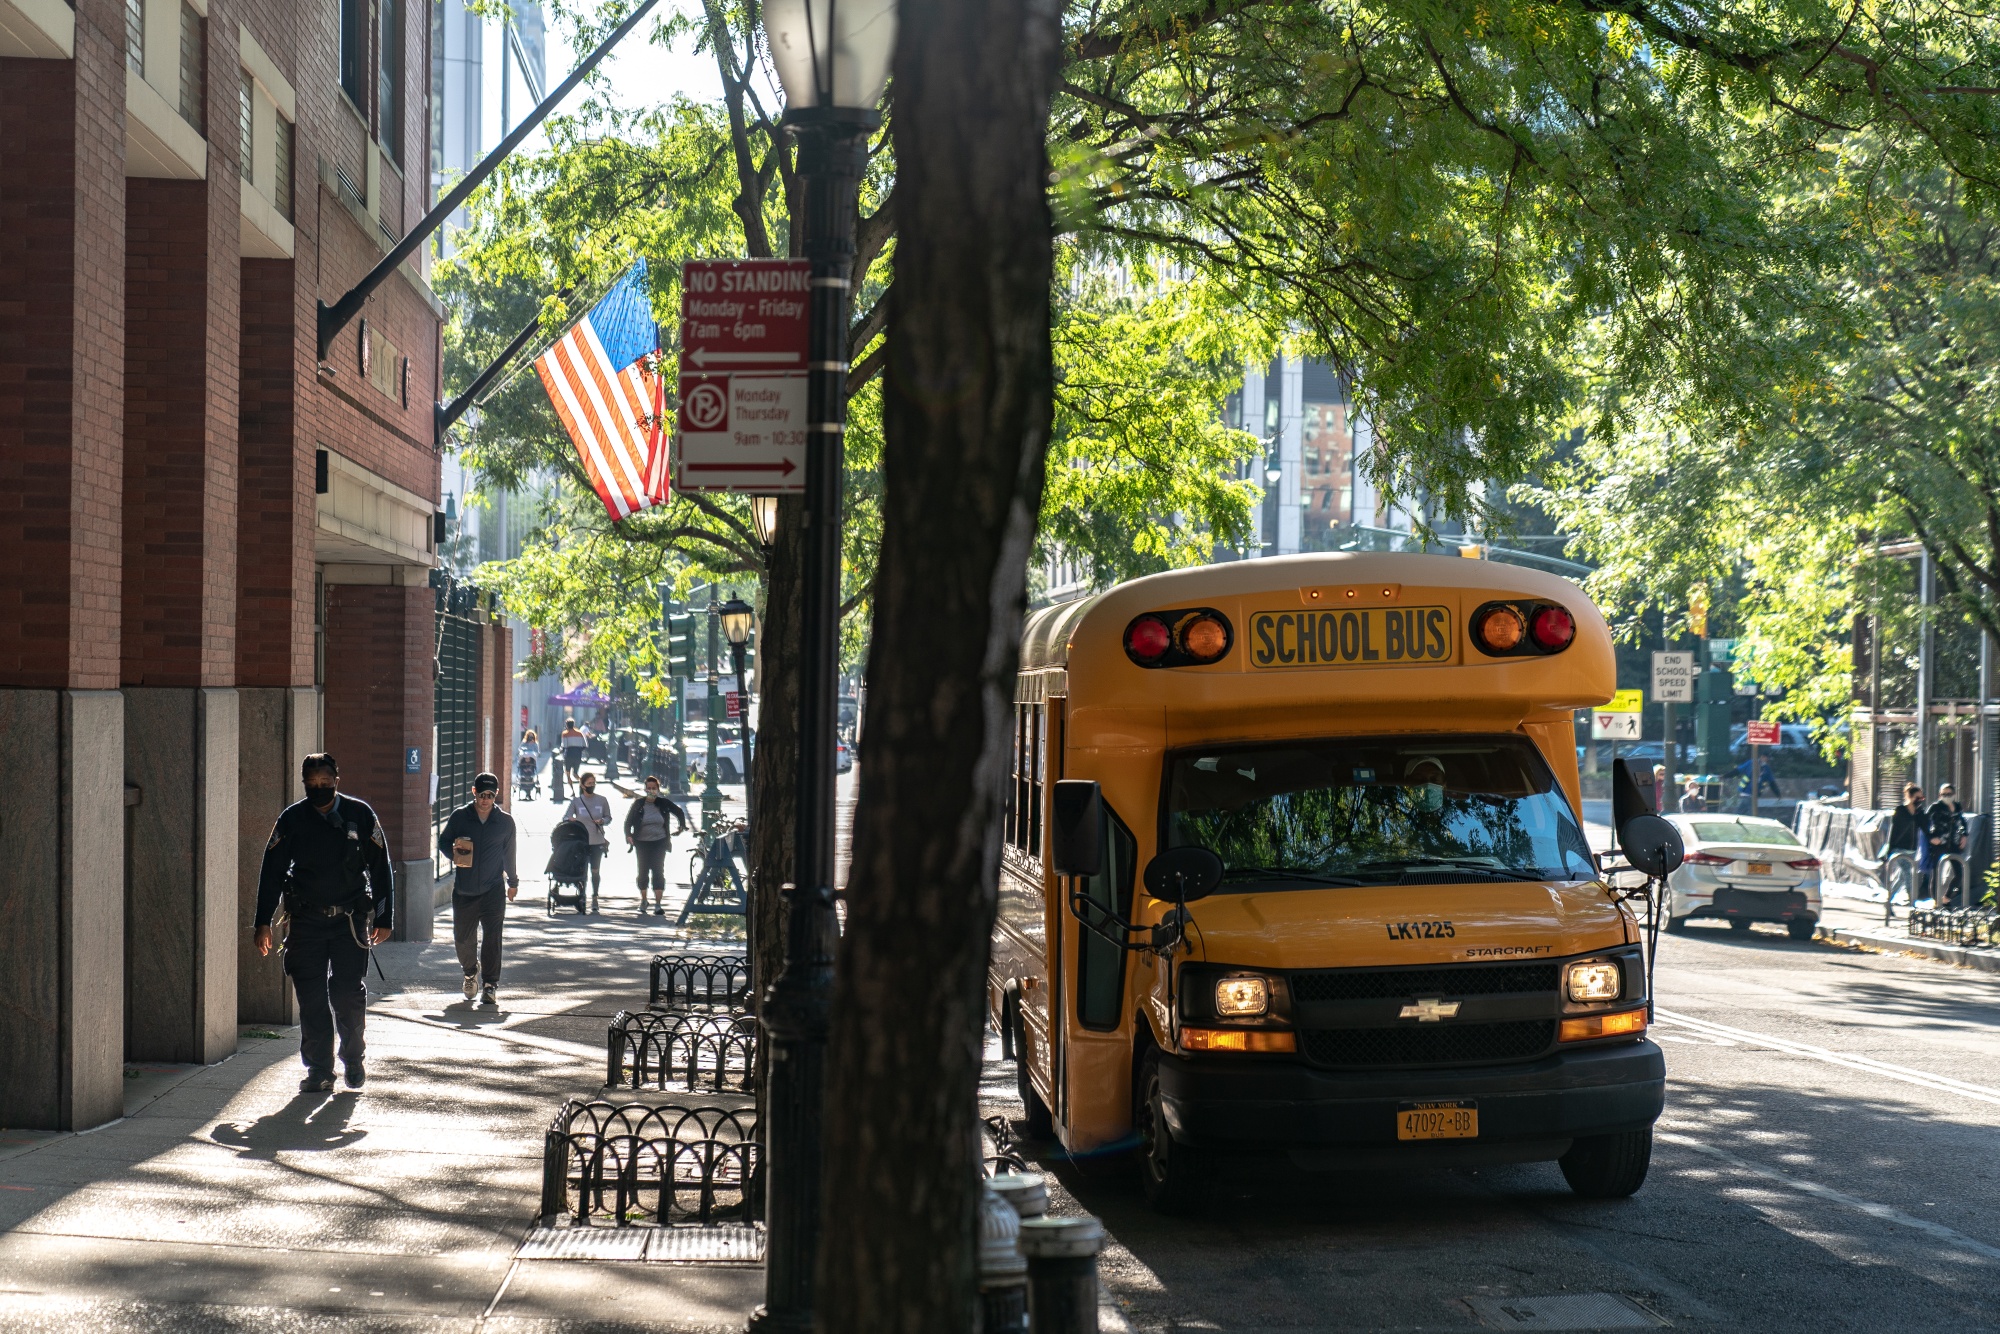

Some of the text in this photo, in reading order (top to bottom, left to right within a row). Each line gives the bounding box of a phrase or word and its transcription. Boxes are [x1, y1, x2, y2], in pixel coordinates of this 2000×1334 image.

[688, 270, 812, 293] NO STANDING
[688, 299, 746, 319] Monday
[758, 299, 804, 319] Friday
[688, 321, 720, 338] 7am
[733, 321, 766, 341] 6pm
[734, 388, 782, 404] Monday
[735, 406, 791, 423] Thursday
[734, 431, 761, 446] 9am
[772, 430, 805, 446] 10:30
[1256, 609, 1447, 665] SCHOOL BUS
[1664, 656, 1681, 664] END
[1656, 667, 1690, 676] SCHOOL
[1659, 678, 1687, 687] SPEED
[1661, 690, 1683, 698] LIMIT
[1385, 921, 1456, 941] LK1225
[1466, 945, 1553, 957] STARCRAFT
